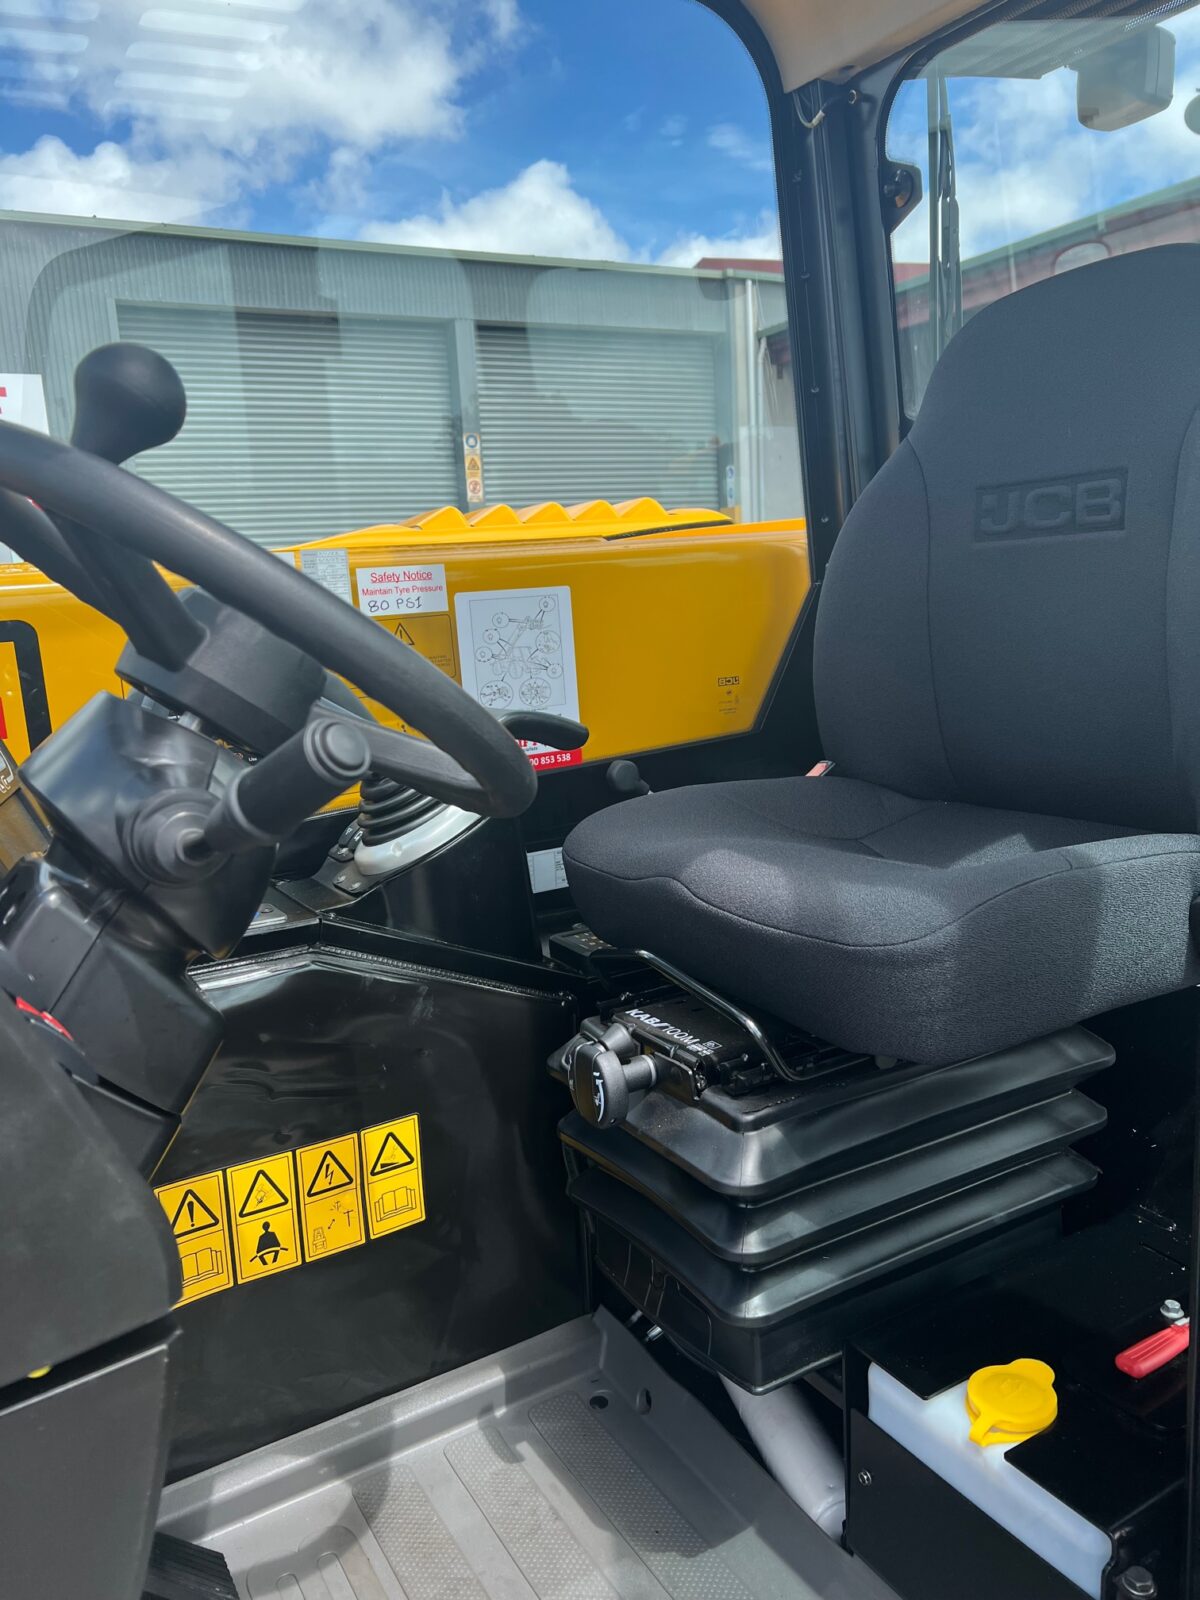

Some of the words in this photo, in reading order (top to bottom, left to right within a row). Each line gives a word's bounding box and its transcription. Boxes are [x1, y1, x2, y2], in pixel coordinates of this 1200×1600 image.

[979, 478, 1122, 536] JCB
[370, 572, 400, 583] Safety
[402, 570, 433, 581] Notice
[361, 587, 393, 596] Maintain
[395, 586, 411, 595] Tyre
[412, 584, 443, 593] Pressure
[367, 600, 390, 613] 80
[396, 596, 423, 609] PSI
[540, 755, 555, 765] 853
[556, 752, 571, 763] 538
